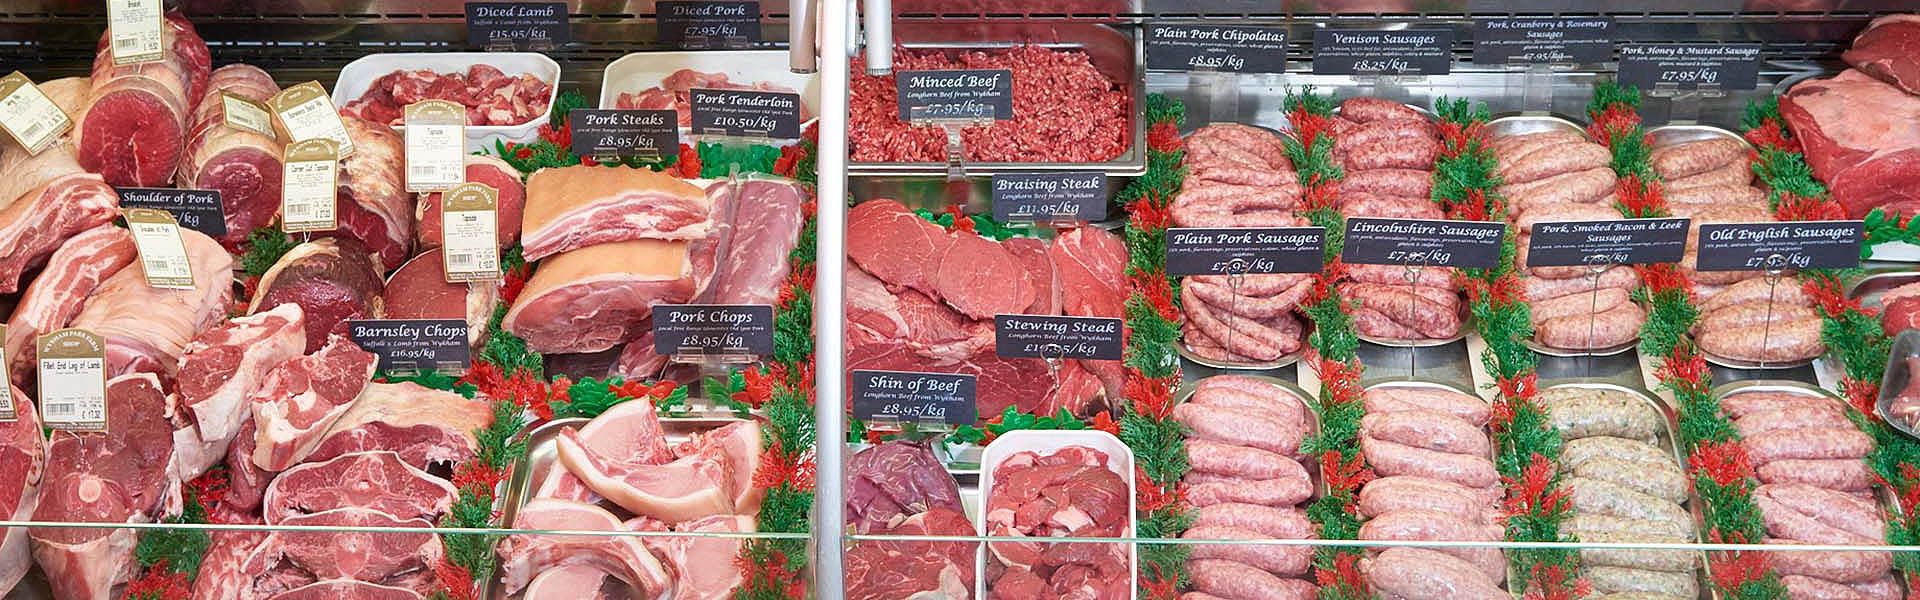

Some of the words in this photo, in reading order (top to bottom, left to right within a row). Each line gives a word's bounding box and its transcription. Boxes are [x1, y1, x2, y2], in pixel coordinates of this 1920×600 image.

[476, 6, 514, 17] Diced
[517, 6, 554, 17] Lamb
[672, 4, 713, 16] Diced
[714, 4, 745, 16] Pork
[684, 24, 737, 38] £7.95/kg
[1487, 21, 1509, 29] Pork,
[1511, 20, 1554, 29] Cranberry
[1566, 20, 1608, 29] Rosemary
[488, 26, 546, 39] £15.95/kg
[1154, 27, 1187, 38] Plain
[1190, 29, 1220, 40] Pork
[1222, 29, 1284, 43] Chipolatas
[1527, 31, 1563, 40] Sausages
[1332, 33, 1379, 44] Venison
[1382, 33, 1436, 47] Sausages
[1622, 46, 1644, 55] Pork,
[1646, 46, 1675, 56] Honey
[1677, 47, 1683, 55] &
[1685, 46, 1724, 55] Mustard
[1724, 47, 1760, 56] Sausages
[1188, 54, 1244, 70] £8.95/kg
[1353, 58, 1408, 72] £8.25/kg
[1662, 68, 1717, 82] £7.95/kg
[909, 74, 967, 88] Minced
[967, 74, 1001, 91] Beef
[696, 93, 726, 105] Pork
[728, 95, 793, 108] Tenderloin
[926, 100, 984, 116] £7.95/kg
[585, 113, 618, 125] Pork
[621, 113, 664, 125] Steaks
[714, 116, 776, 131] £10.50/kg
[598, 134, 654, 148] £8.95/kg
[997, 179, 1057, 193] Braising
[1061, 177, 1099, 190] Steak
[124, 192, 171, 203] Shoulder
[174, 192, 185, 205] of
[187, 194, 214, 204] Pork
[1018, 201, 1080, 216] £11.95/kg
[1352, 222, 1436, 235] Lincolnshire
[1439, 226, 1499, 240] Sausages
[1542, 223, 1570, 234] Pork,
[1572, 222, 1614, 233] Smoked
[1614, 222, 1646, 232] Bacon
[1648, 222, 1657, 230] &
[1659, 221, 1683, 230] Leek
[1174, 233, 1212, 245] Plain
[1217, 232, 1252, 244] Pork
[1256, 233, 1319, 246] Sausages
[1586, 234, 1632, 244] Sausages
[1710, 228, 1737, 241] Old
[1738, 227, 1790, 243] English
[1793, 227, 1855, 241] Sausages
[669, 310, 705, 323] Pork
[710, 310, 753, 326] Chops
[354, 324, 420, 340] Barnsley
[424, 324, 466, 340] Chops
[1005, 320, 1068, 334] Stewing
[1072, 321, 1115, 333] Steak
[682, 333, 743, 348] £8.95/kg
[391, 348, 435, 359] £16.95/kg
[869, 376, 903, 389] Shin
[908, 377, 926, 393] of
[927, 379, 963, 395] Beef
[882, 403, 945, 417] £8.95/kg
